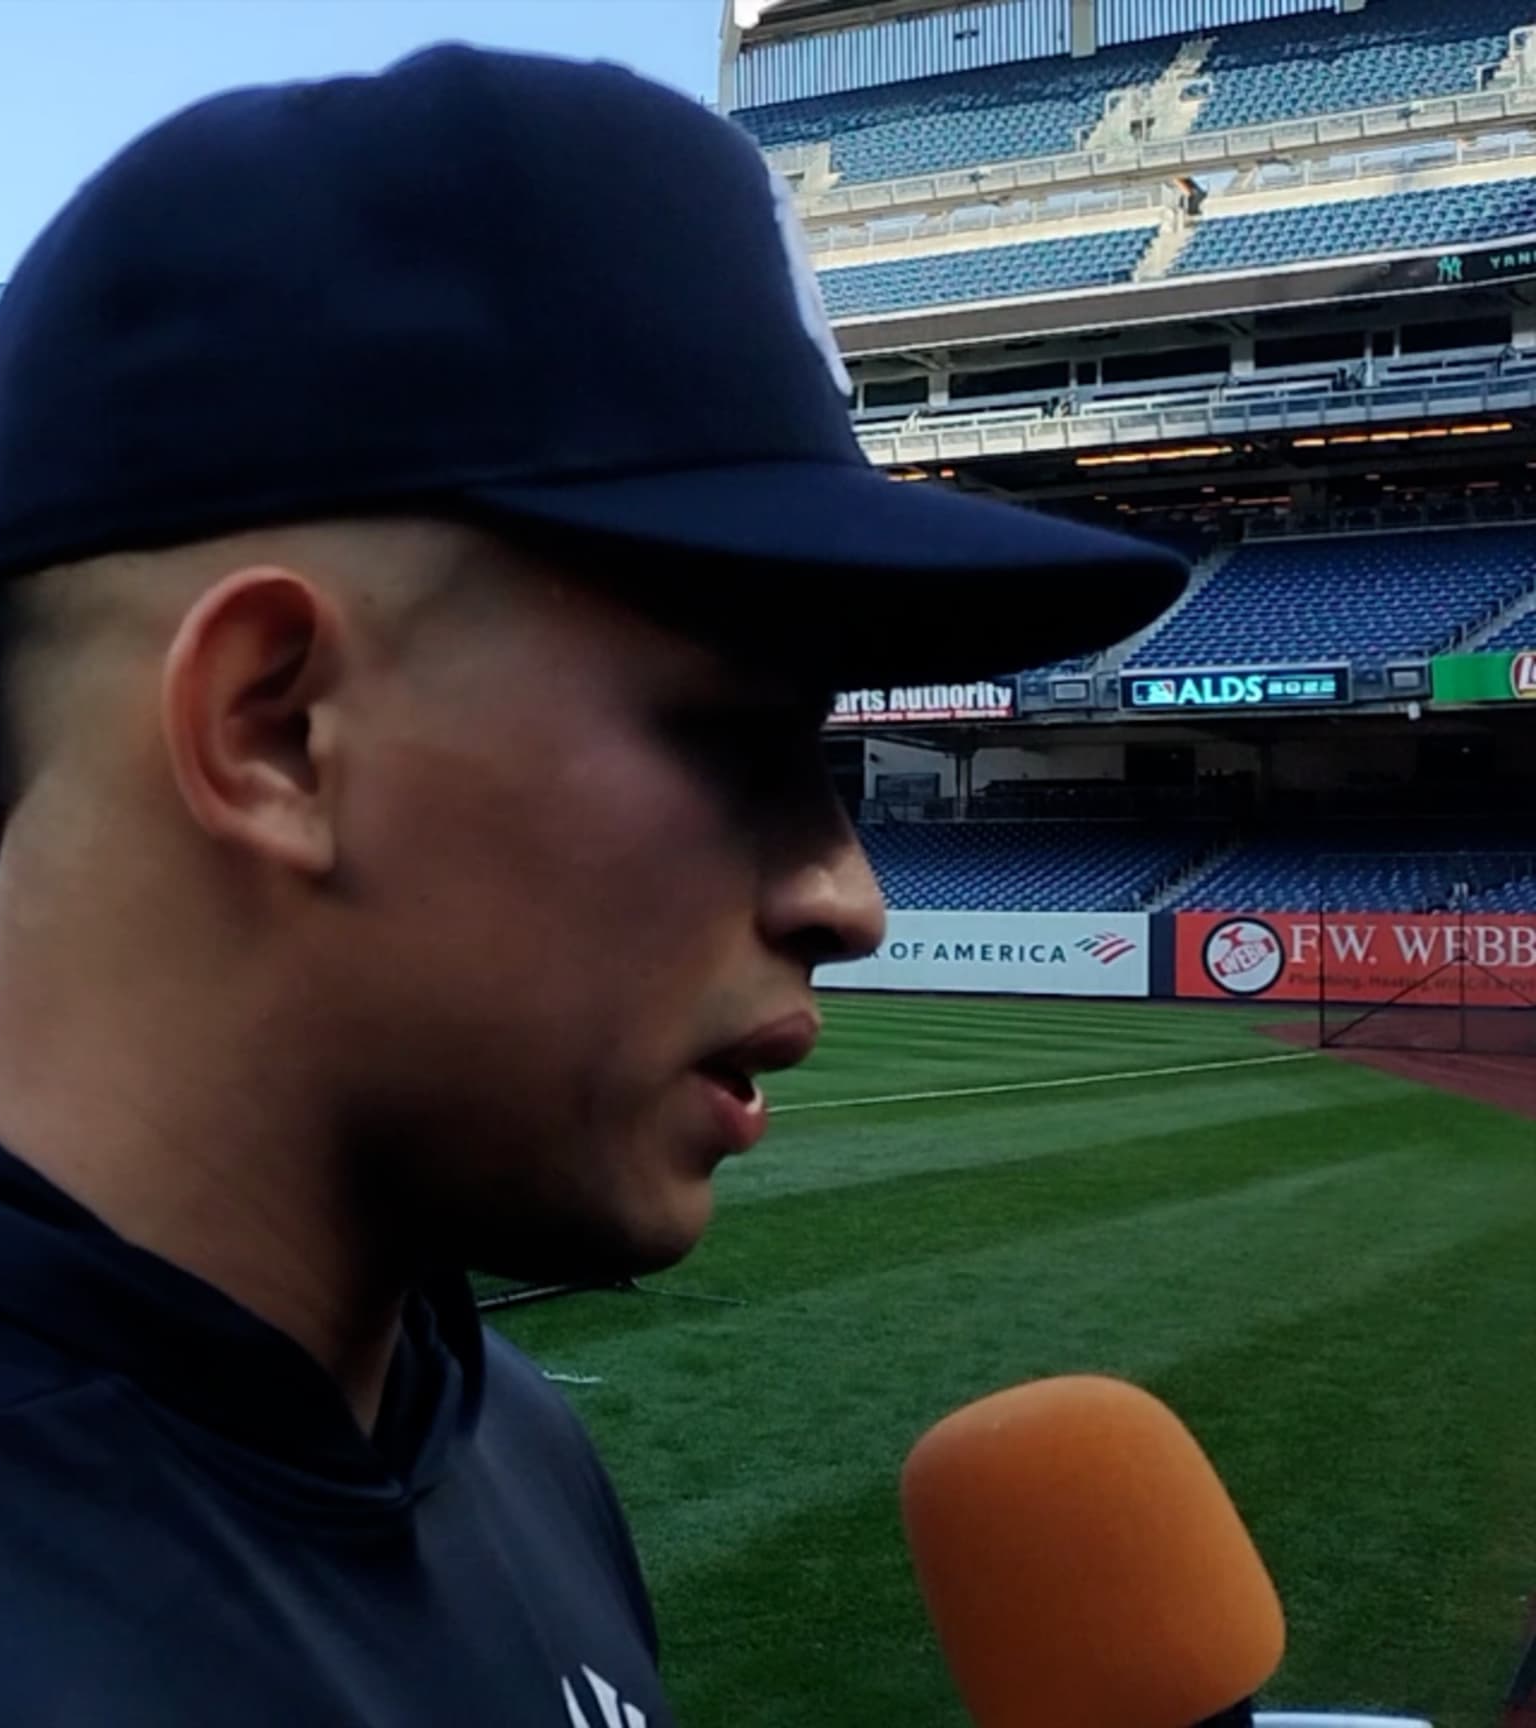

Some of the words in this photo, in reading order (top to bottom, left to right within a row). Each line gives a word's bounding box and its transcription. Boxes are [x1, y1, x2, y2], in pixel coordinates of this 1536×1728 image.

[1177, 677, 1263, 703] ALDS
[1268, 680, 1336, 694] 2022
[890, 942, 925, 960] OF
[933, 943, 1067, 963] AMERICA
[1393, 925, 1536, 967] WEBB
